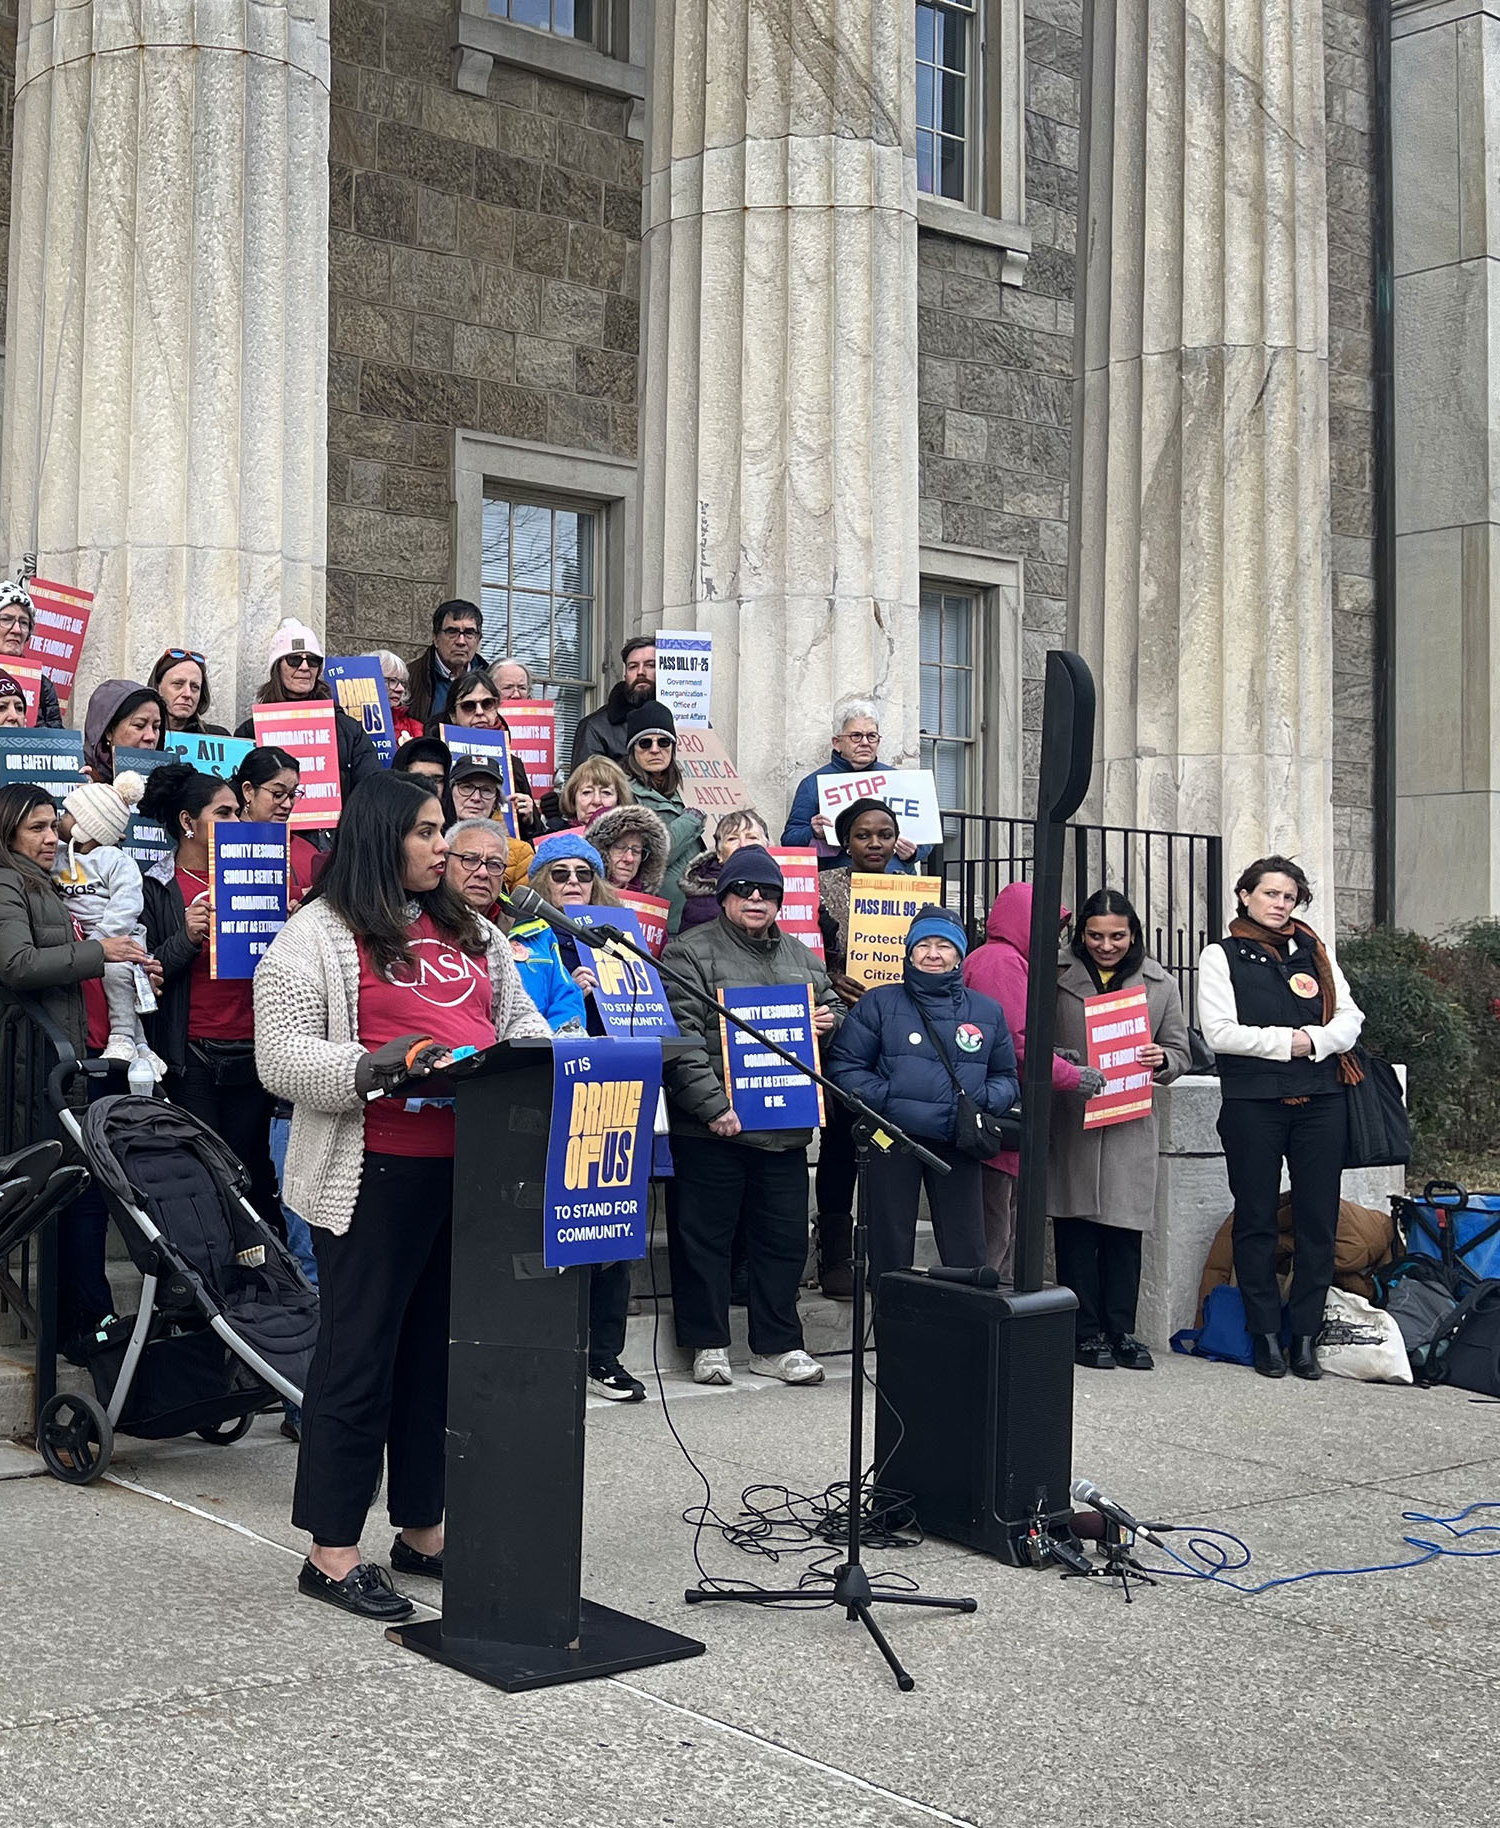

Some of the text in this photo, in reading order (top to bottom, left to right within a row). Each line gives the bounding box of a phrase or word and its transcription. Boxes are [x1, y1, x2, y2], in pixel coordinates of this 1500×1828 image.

[659, 656, 709, 671] PASS BILL 97-25
[328, 669, 335, 677] IT
[667, 678, 702, 686] Government
[363, 704, 382, 732] US
[315, 729, 330, 744] ARE
[6, 754, 79, 770] OUR SAFETY COMES
[678, 760, 739, 778] MERICA
[694, 787, 741, 805] ANTI-
[824, 775, 886, 806] STOP
[220, 844, 251, 858] COUNTY
[223, 870, 253, 885] SHOULD
[855, 899, 880, 914] PASS
[881, 901, 901, 916] BILL
[584, 916, 593, 924] IS
[850, 951, 869, 960] for
[384, 951, 488, 987] CASA
[602, 1003, 664, 1012] TO STAND FOR
[609, 1017, 666, 1026] COMMUNITY.
[789, 1028, 804, 1041] THE
[564, 1057, 591, 1076] IT IS
[569, 1081, 644, 1136] BRAVE
[564, 1131, 631, 1190] OF US
[555, 1200, 638, 1219] TO STAND FOR
[557, 1223, 634, 1243] COMMUNITY.
